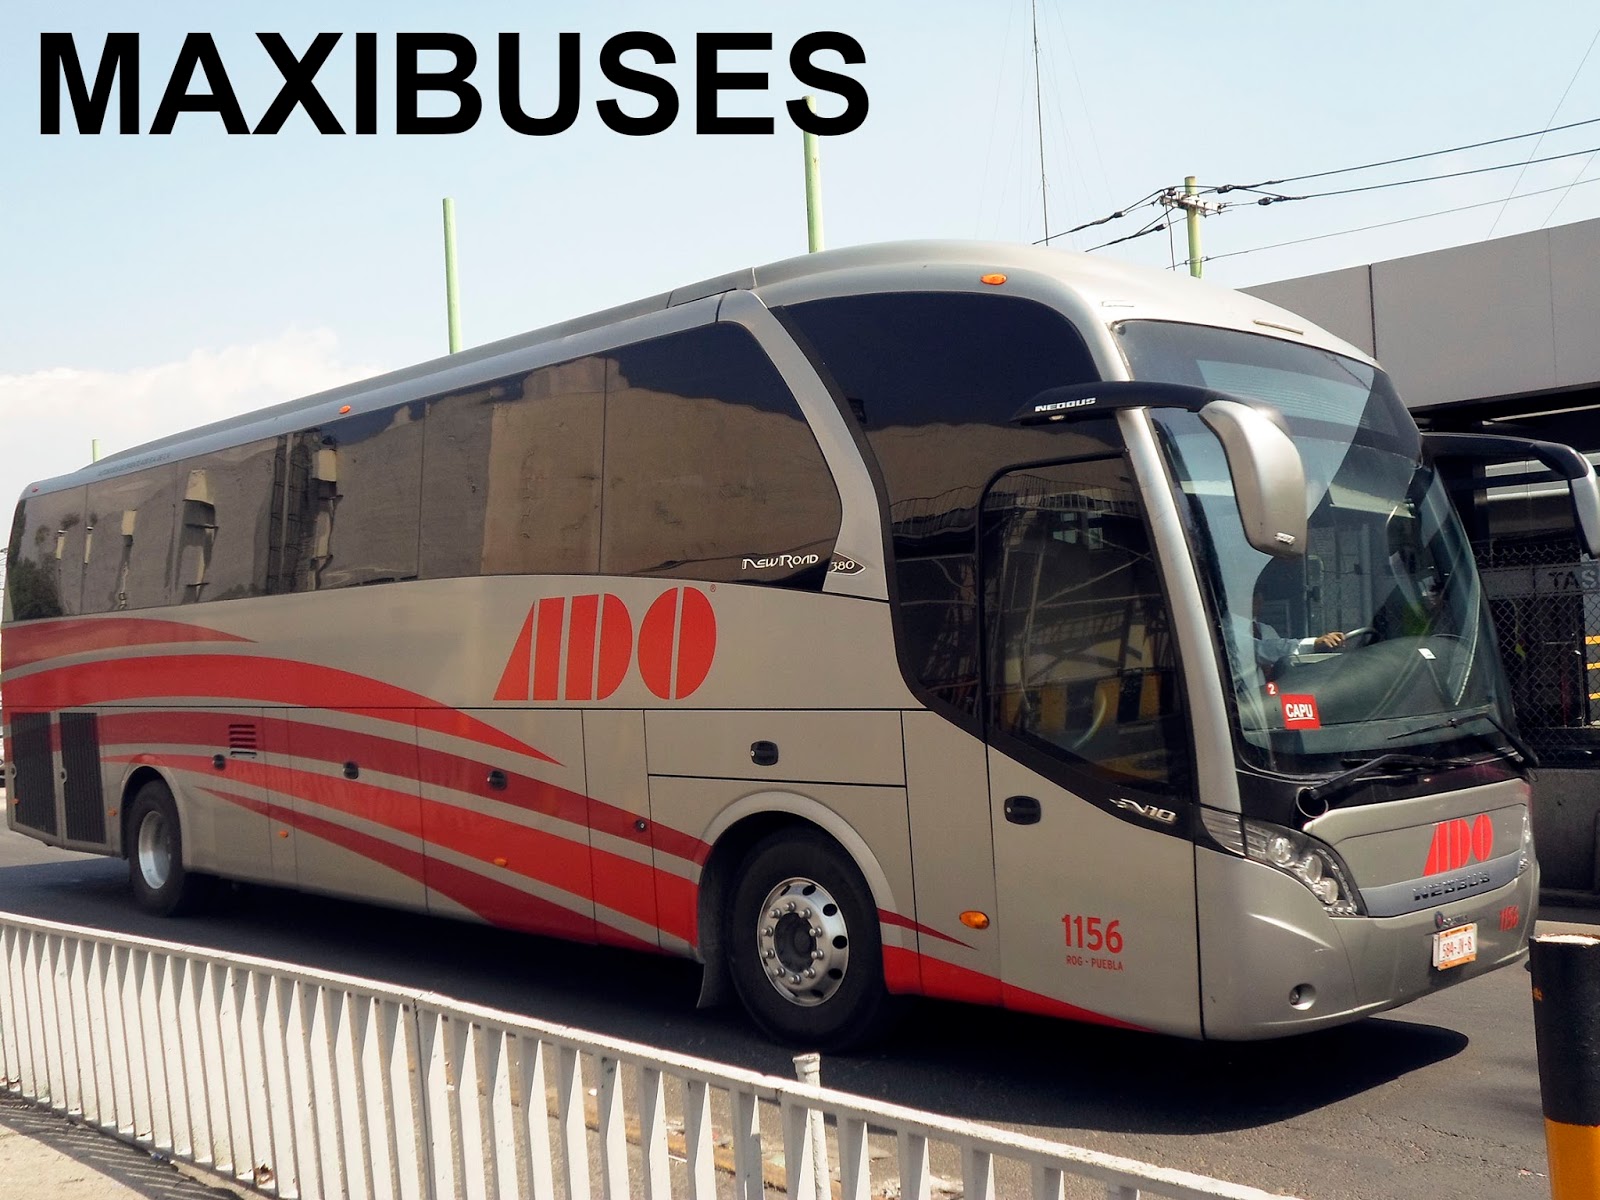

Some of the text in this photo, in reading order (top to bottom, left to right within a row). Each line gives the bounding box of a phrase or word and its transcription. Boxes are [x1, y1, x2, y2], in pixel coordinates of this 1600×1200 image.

[831, 560, 855, 572] 380
[493, 586, 717, 701] ADO
[1267, 683, 1276, 695] 2
[1285, 703, 1314, 718] CAPU
[1423, 813, 1494, 877] ADO
[1061, 914, 1123, 954] 1156
[1066, 955, 1083, 967] ROG
[1091, 958, 1123, 971] PUEBLA
